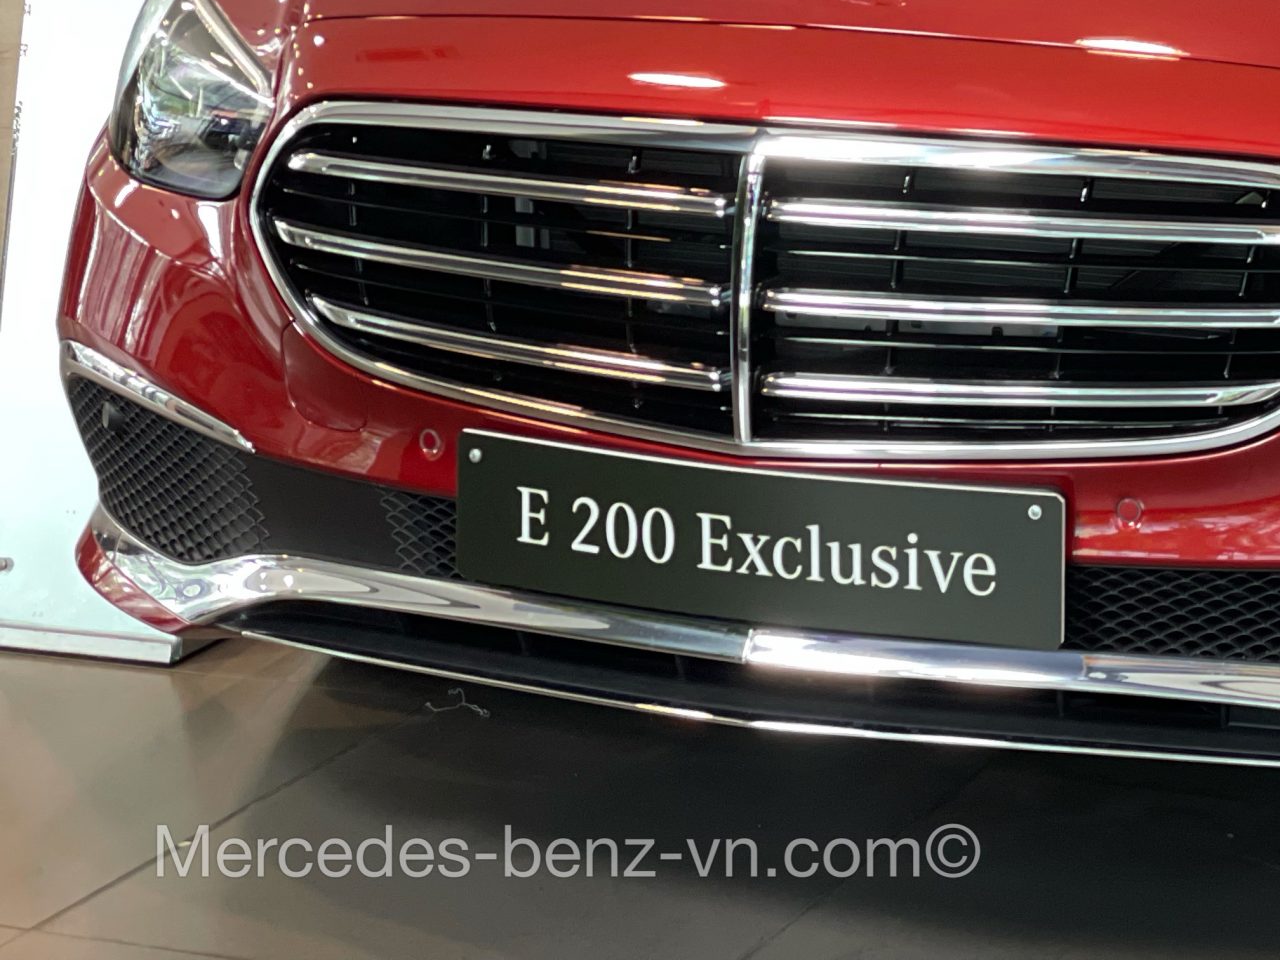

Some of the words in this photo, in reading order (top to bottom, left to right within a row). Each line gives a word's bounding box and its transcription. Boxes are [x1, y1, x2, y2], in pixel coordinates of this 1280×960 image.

[516, 486, 550, 547] E
[570, 496, 676, 565] 200
[695, 511, 997, 597] Exclusive
